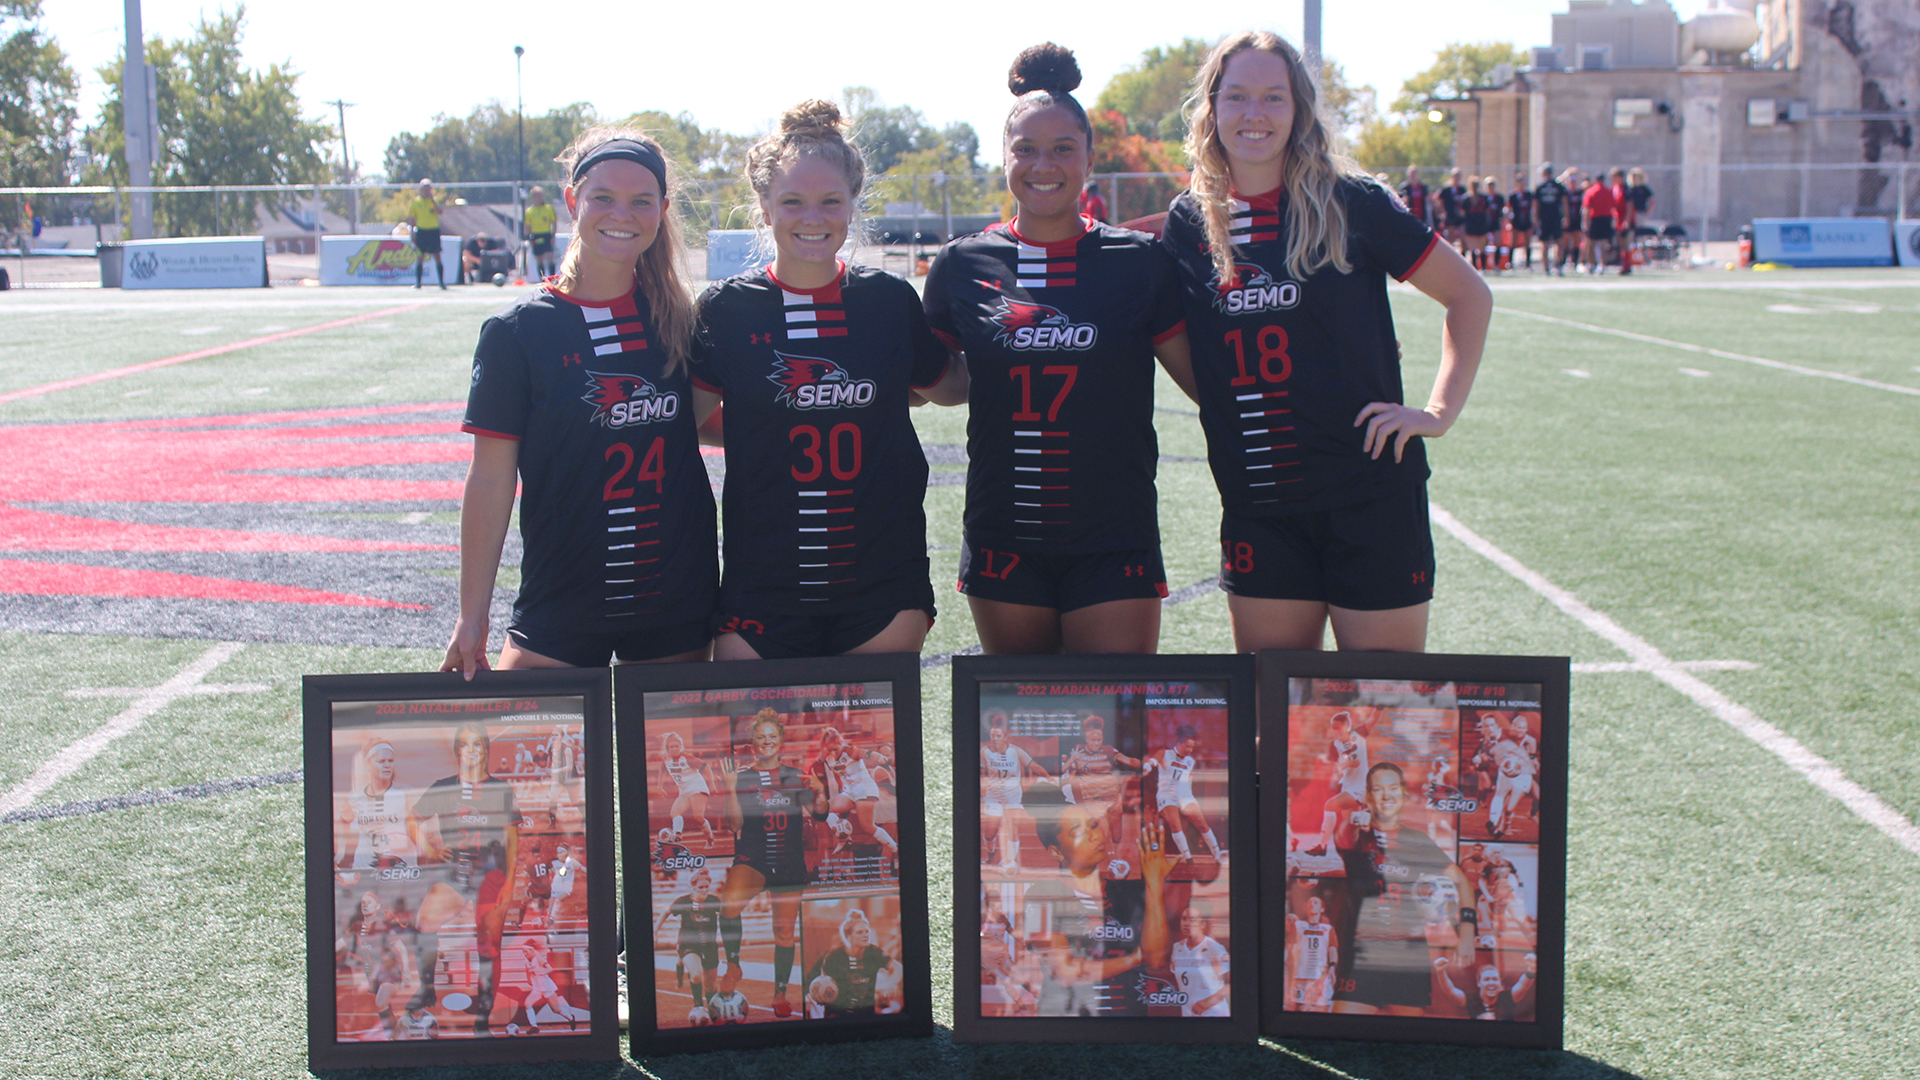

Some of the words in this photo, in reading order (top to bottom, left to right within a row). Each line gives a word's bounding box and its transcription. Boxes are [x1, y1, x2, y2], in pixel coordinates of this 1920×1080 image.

[1227, 283, 1298, 313] SEMO
[1014, 326, 1095, 348] SEMO
[1224, 325, 1292, 387] 18
[797, 382, 873, 406] SEMO
[1009, 365, 1078, 422] 17
[610, 393, 678, 424] SEMO
[789, 422, 862, 482] 30
[603, 436, 666, 501] 24
[979, 548, 1020, 580] 17
[1223, 540, 1254, 573] 18
[671, 692, 701, 704] 2022
[704, 690, 748, 702] GABBY
[750, 686, 837, 700] GSCHEIDMIER
[840, 686, 864, 696] #30
[1018, 686, 1047, 696] 2022
[1050, 686, 1101, 695] MARIAH
[1103, 686, 1164, 695] MANNINO
[1168, 685, 1189, 694] #17
[1326, 682, 1355, 693] 2022
[1358, 682, 1414, 694] MORGAN
[1483, 686, 1506, 697] #18
[376, 704, 406, 715] 2022
[409, 702, 462, 714] NATALIE
[464, 702, 512, 712] MILLER
[514, 700, 538, 711] #24
[812, 700, 850, 708] IMPOSSIBLE
[860, 698, 892, 706] NOTHING.
[501, 714, 540, 722] IMPOSSIBLE
[550, 713, 584, 721] NOTHING.
[998, 770, 1008, 778] 17
[1172, 769, 1182, 780] 17
[766, 798, 790, 806] SEMO
[1438, 800, 1476, 812] SEMO
[462, 815, 488, 824] SEMO
[764, 810, 788, 831] 30
[458, 829, 482, 851] 24
[534, 863, 546, 877] 16
[665, 856, 704, 869] SEMO
[1378, 864, 1409, 876] SEMO
[382, 868, 420, 880] SEMO
[1376, 880, 1402, 905] 18
[1094, 926, 1133, 940] SEMO
[1308, 938, 1319, 949] 18
[1181, 971, 1188, 986] 6
[1338, 978, 1356, 993] 18
[1149, 993, 1188, 1005] SEMO
